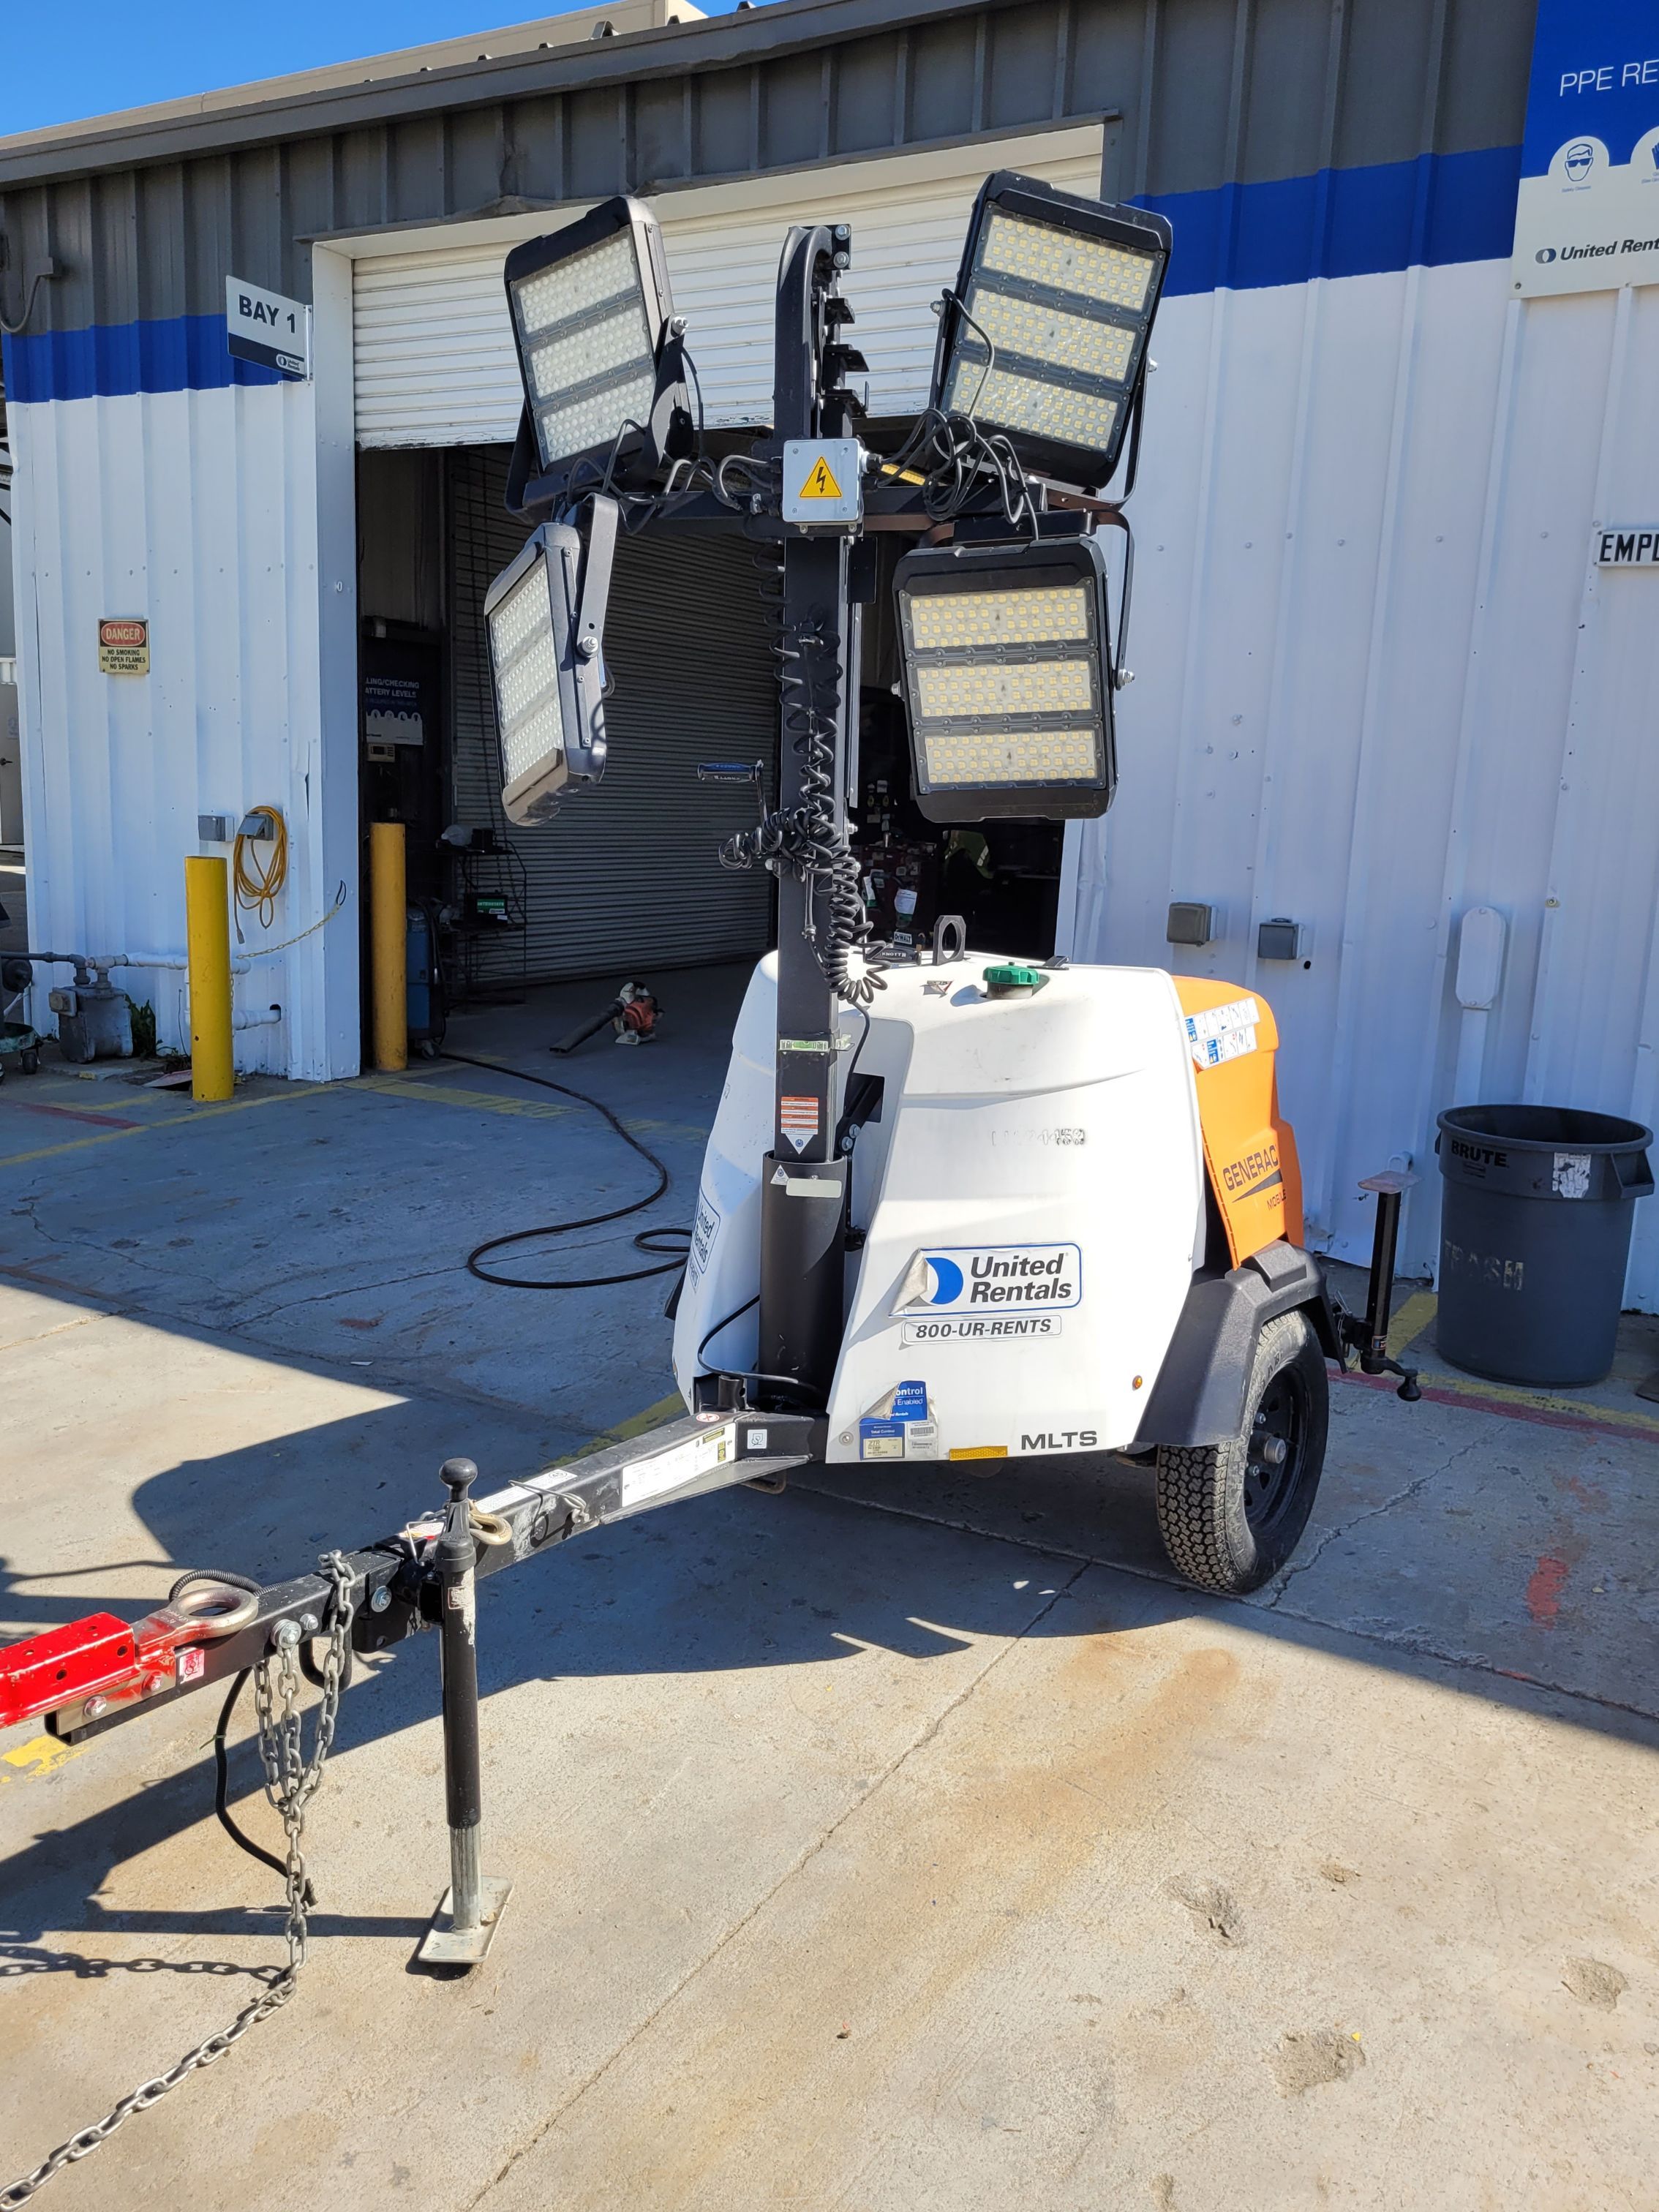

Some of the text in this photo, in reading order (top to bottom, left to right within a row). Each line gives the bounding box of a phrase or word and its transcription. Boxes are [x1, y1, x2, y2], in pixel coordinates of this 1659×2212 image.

[1560, 59, 1659, 97] PPE RE
[1560, 241, 1618, 260] United
[239, 294, 296, 334] BAY 1
[105, 628, 140, 641] DANGER
[1451, 1140, 1508, 1167] BRUTE
[1223, 1145, 1279, 1191] GENERAC
[1266, 1189, 1287, 1211] MOBILE
[971, 1253, 1064, 1279] United
[970, 1278, 1072, 1303] Rentals
[916, 1318, 1052, 1338] 800-UR-RENTS
[1021, 1431, 1097, 1450] MLTS
